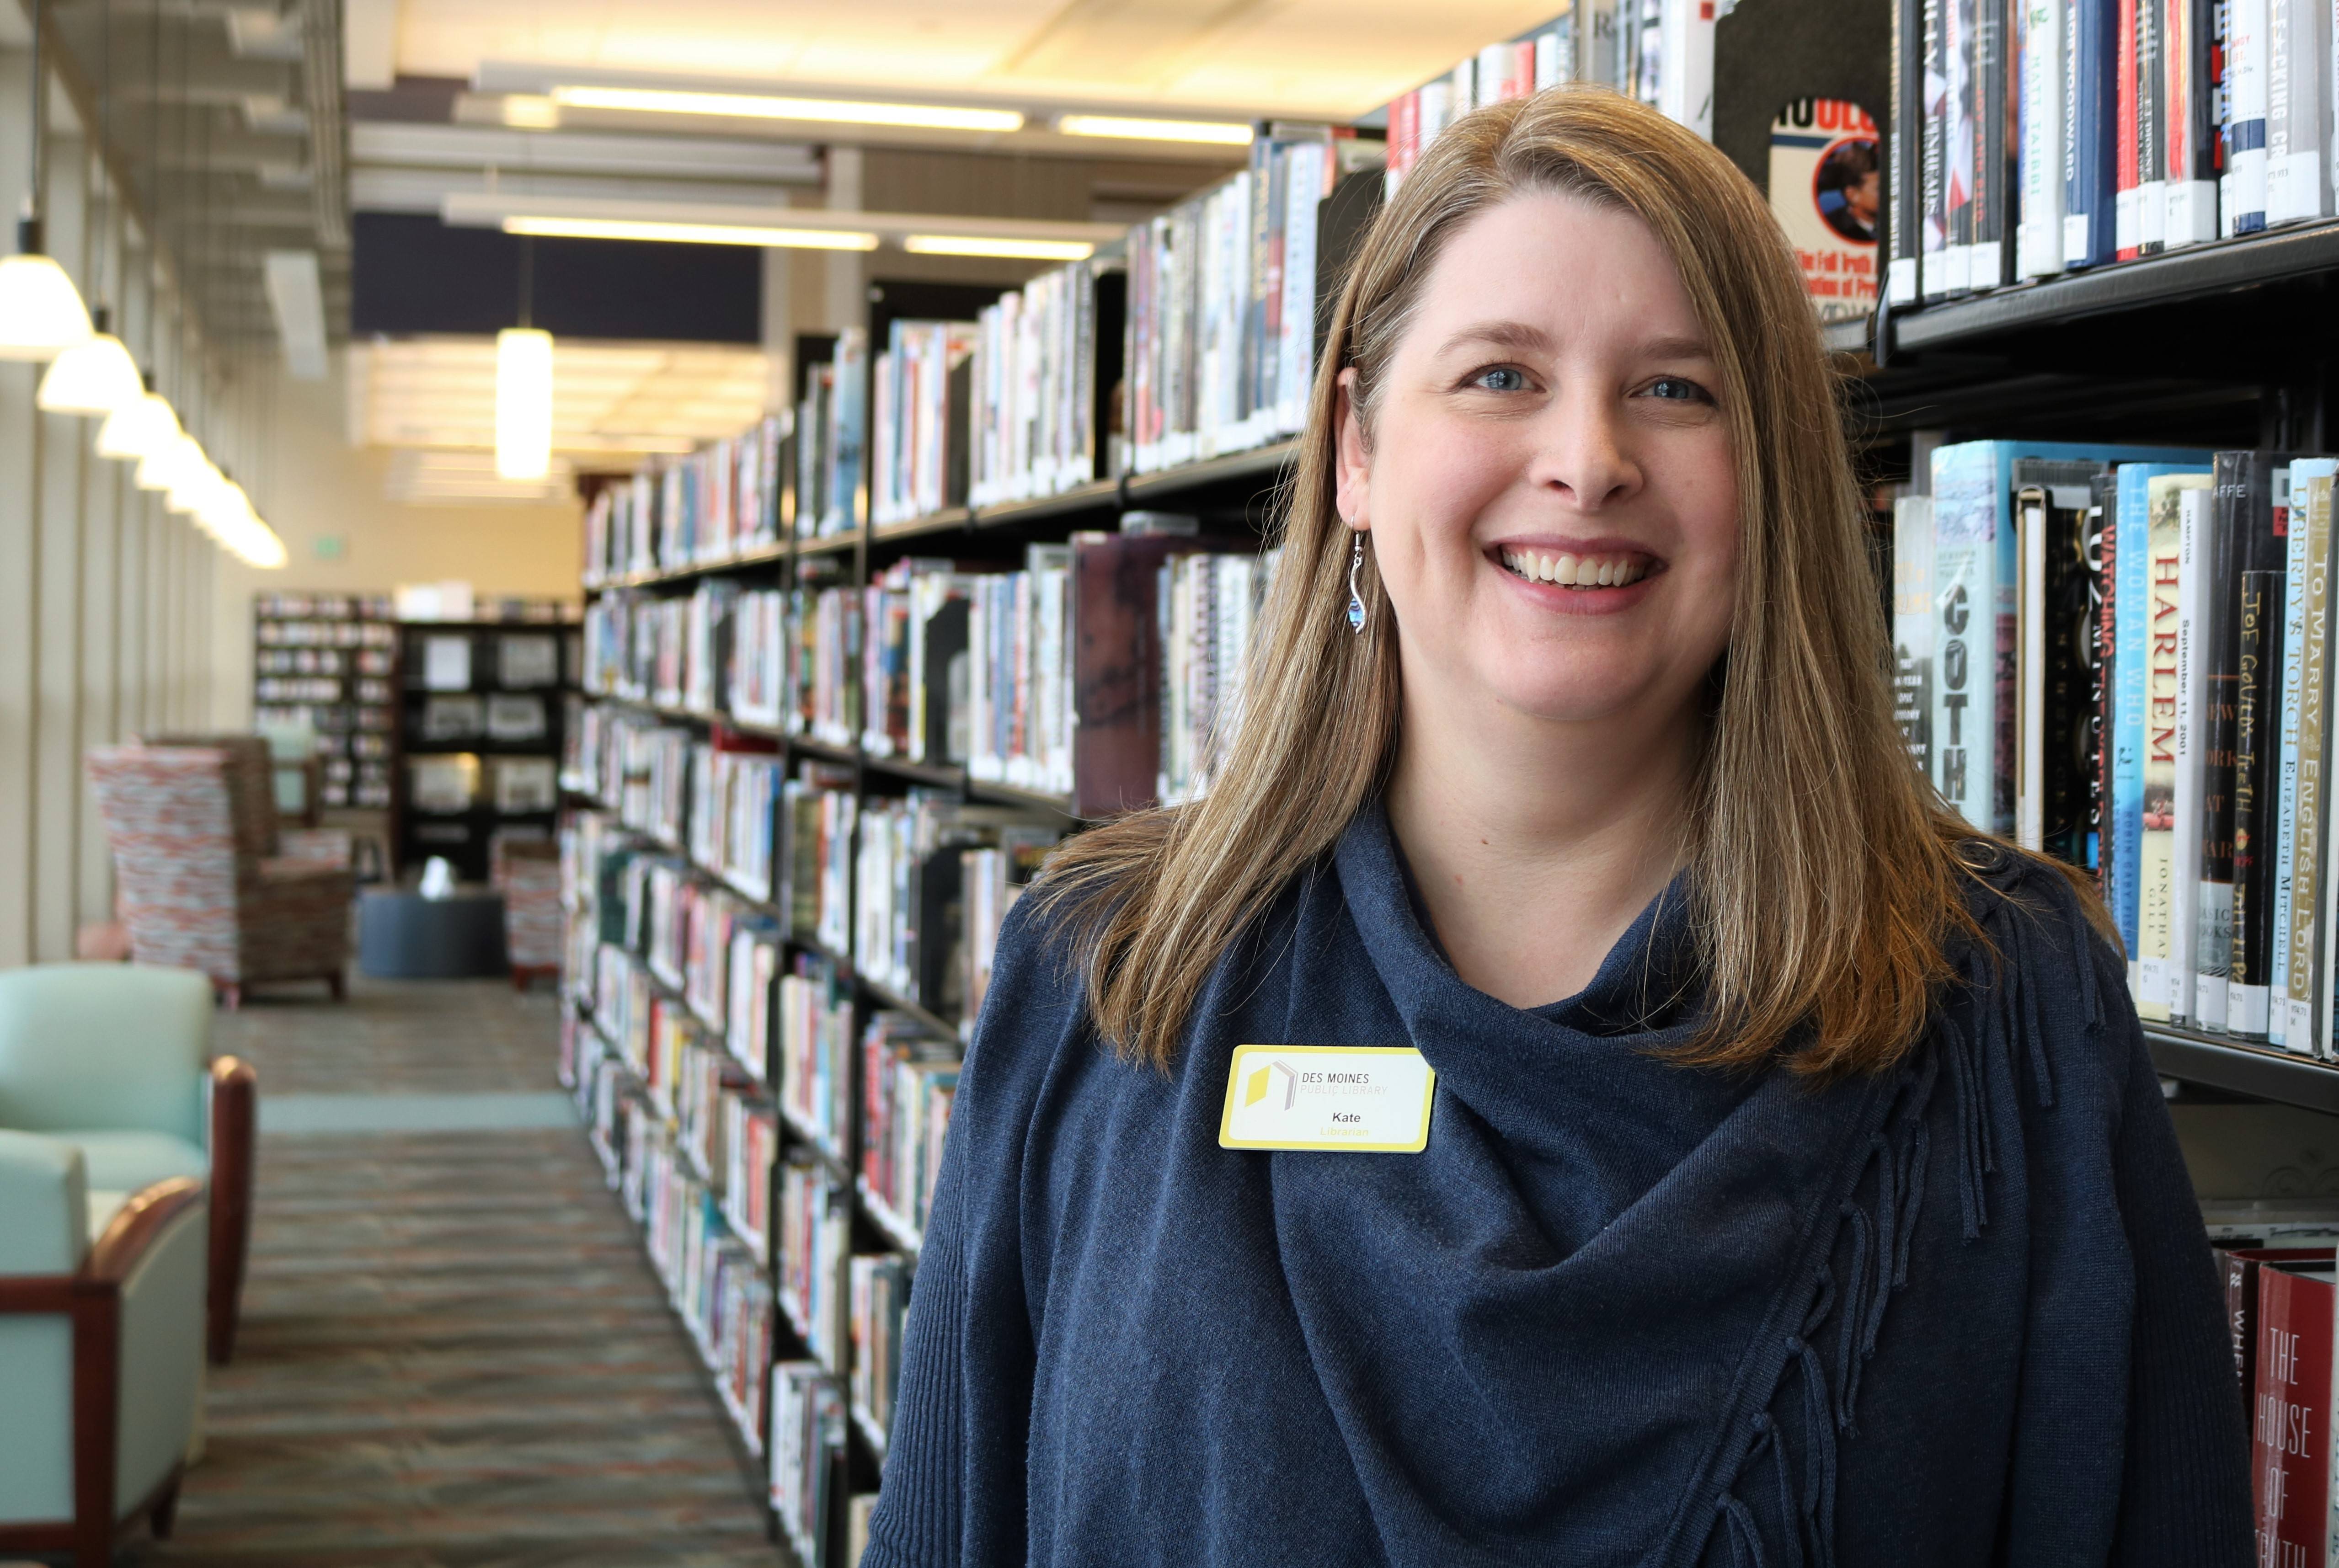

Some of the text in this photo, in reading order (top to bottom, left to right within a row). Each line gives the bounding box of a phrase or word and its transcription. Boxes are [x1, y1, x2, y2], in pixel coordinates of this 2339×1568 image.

[2031, 55, 2040, 107] MATT
[2066, 54, 2075, 181] WOODWARD
[2099, 524, 2116, 658] WATCHING
[2126, 487, 2146, 727] THE WOMAN WHO
[2312, 553, 2328, 595] TO
[2285, 487, 2307, 747] LIBERTY'S TORCH
[2151, 553, 2179, 766] HARLEM
[2181, 619, 2190, 696] September
[2307, 607, 2325, 726] MARRY
[1943, 584, 1970, 814] GOTH
[2179, 725, 2188, 755] 2001
[2124, 810, 2134, 854] ROBIN
[2298, 759, 2318, 897] ENGLISH
[2277, 761, 2296, 971] ELIZABETH MITCHELL
[2293, 908, 2310, 992] LORD
[1300, 1085, 1388, 1095] PUBLIC LIBRARY
[1302, 1073, 1369, 1083] DES MOINES
[1320, 1127, 1369, 1136] Librarian
[1332, 1112, 1361, 1122] Kate
[2270, 1327, 2300, 1386] THE
[2257, 1392, 2312, 1458] HOUSE
[2269, 1467, 2289, 1520] OF
[2254, 1529, 2306, 1568] RUTH
